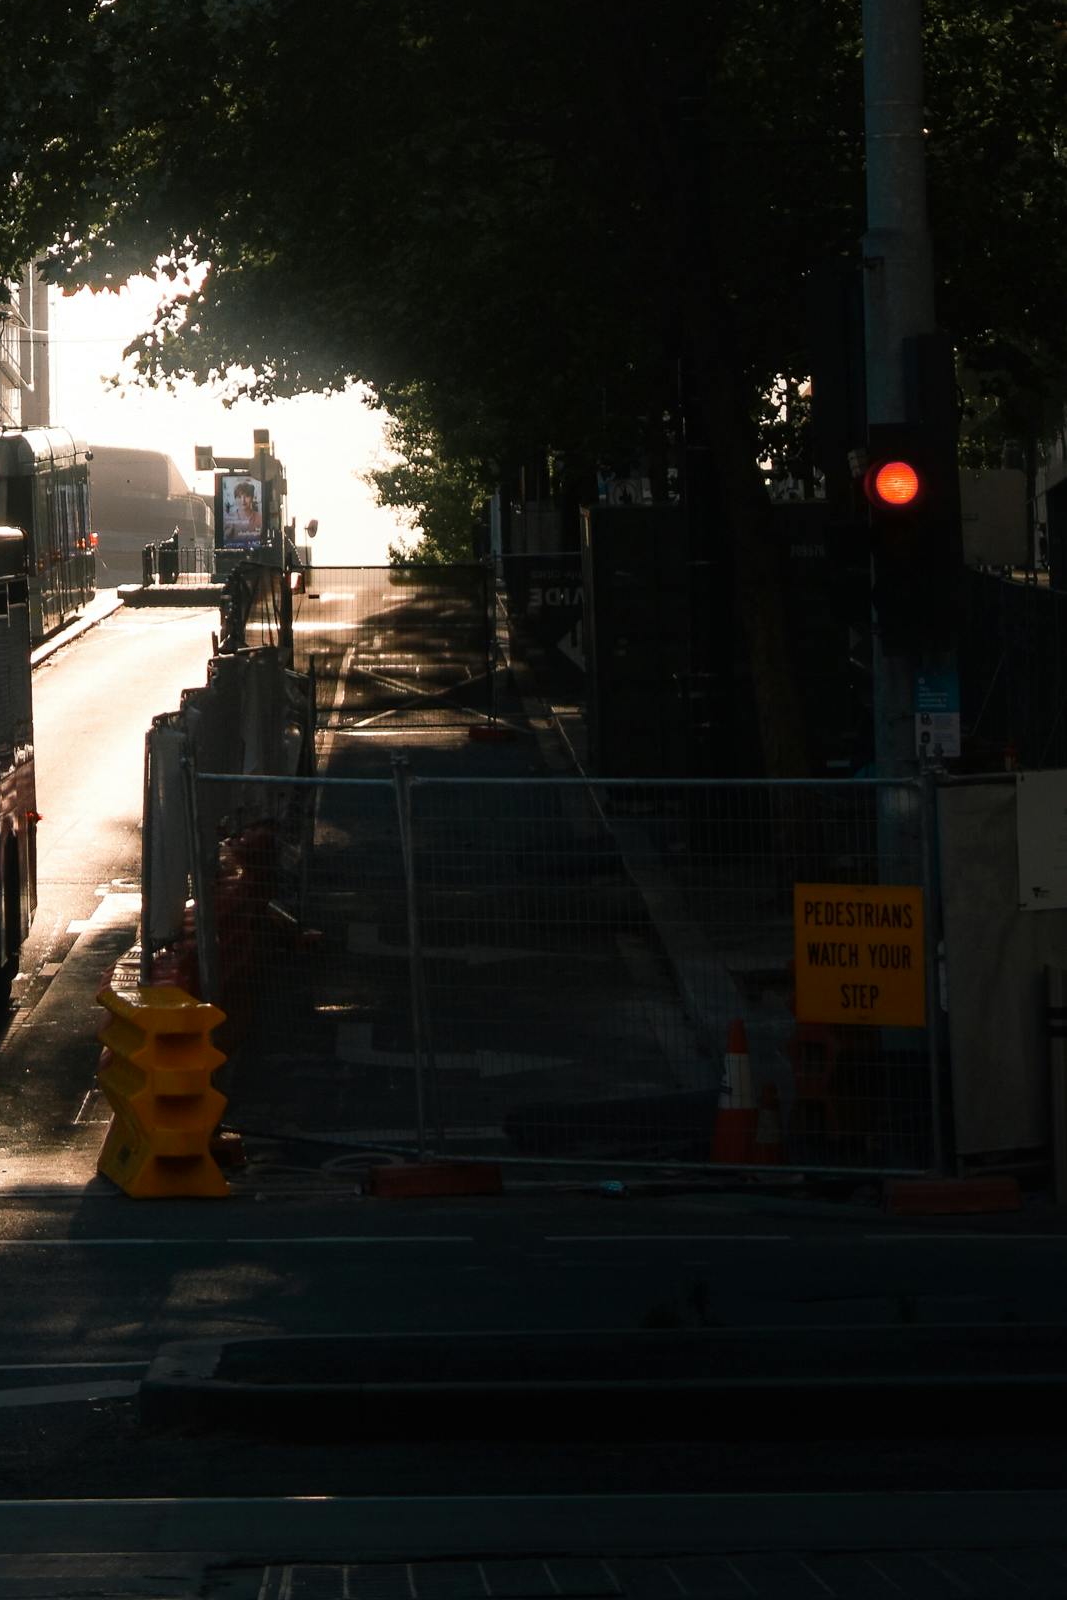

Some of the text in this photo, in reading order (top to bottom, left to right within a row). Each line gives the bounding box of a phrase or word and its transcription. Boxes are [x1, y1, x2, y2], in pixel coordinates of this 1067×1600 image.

[803, 901, 913, 929] PEDESTRIANS
[806, 941, 912, 969] WATCH YOUR
[840, 983, 880, 1009] STEP
